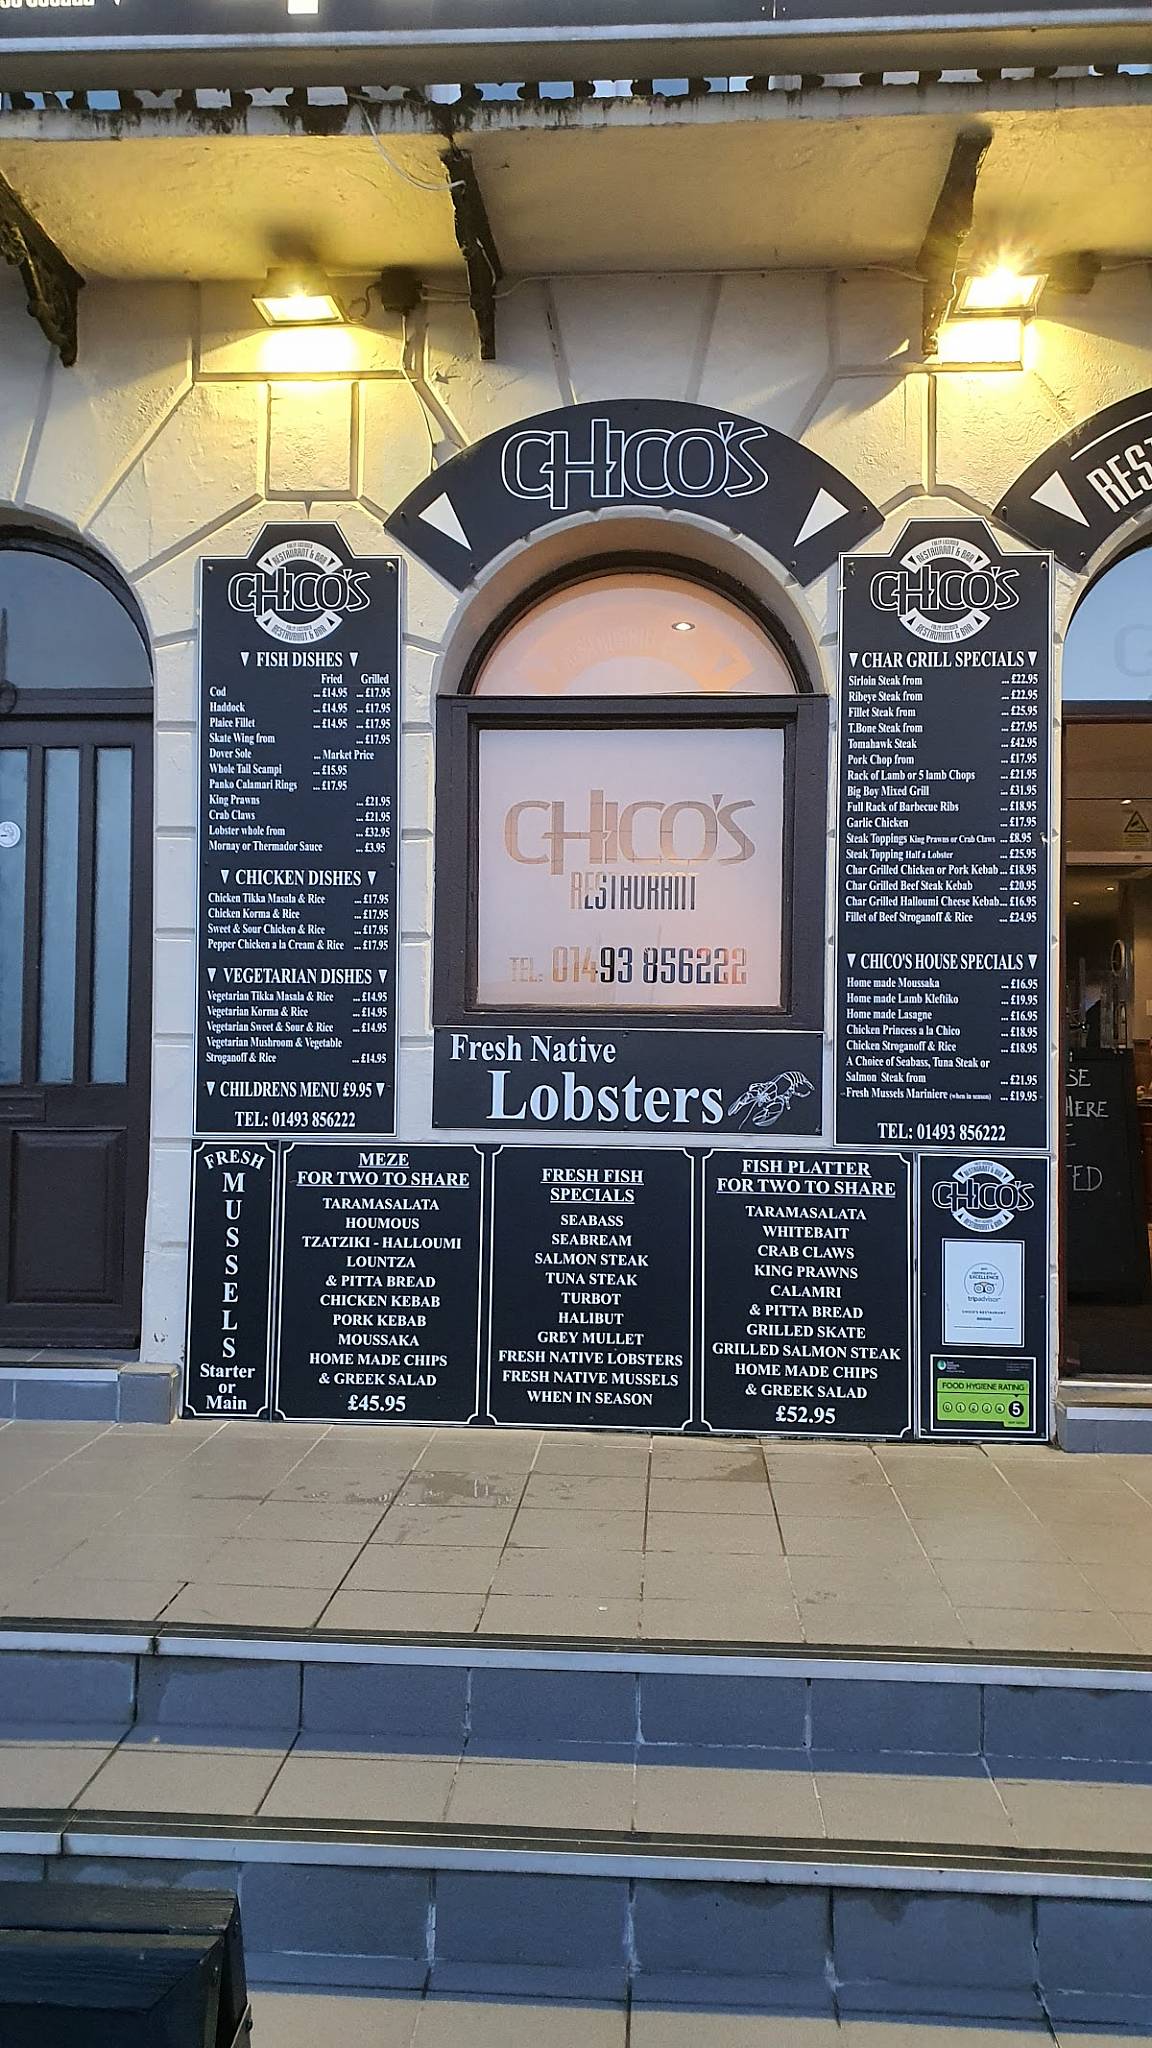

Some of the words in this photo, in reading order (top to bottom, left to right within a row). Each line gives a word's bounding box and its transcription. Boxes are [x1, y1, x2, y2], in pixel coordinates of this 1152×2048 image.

[501, 419, 769, 509] CHICO'S
[1086, 438, 1152, 513] RES
[228, 566, 371, 617] CHICO'S
[870, 565, 1019, 616] CHICO'S
[256, 652, 288, 667] FISH
[292, 652, 343, 667] DISHES
[862, 652, 904, 668] CHAR
[906, 652, 952, 668] GRILL
[955, 651, 1024, 668] SPECIALS
[321, 674, 342, 684] Fried
[360, 674, 389, 684] Grilled
[848, 675, 876, 686] Sirloin
[878, 675, 901, 686] Steak
[902, 675, 922, 686] from
[210, 686, 226, 697] Cod
[210, 702, 245, 712] Haddock
[210, 717, 234, 728] Plaice
[235, 717, 255, 728] Fillet
[848, 722, 877, 733] T.Bone
[878, 722, 901, 733] Steak
[902, 722, 923, 733] from
[209, 732, 232, 743] Skate
[233, 732, 254, 746] Wing
[256, 732, 275, 743] from
[848, 738, 893, 749] Tomahawk
[894, 738, 917, 749] Steak
[209, 763, 235, 774] Whole
[236, 763, 251, 774] Tail
[252, 763, 282, 777] Scampi
[847, 786, 862, 799] Big
[863, 786, 880, 799] Boy
[881, 785, 907, 796] Mixed
[909, 785, 929, 796] Grill
[208, 809, 230, 820] Crab
[231, 809, 256, 820] Claws
[846, 817, 873, 828] Garlic
[874, 817, 908, 828] Chicken
[504, 789, 756, 876] CHICO'S
[235, 869, 305, 886] CHICKEN
[308, 870, 362, 886] DISHES
[208, 908, 240, 918] Chicken
[242, 908, 271, 918] Korma
[272, 908, 280, 919] &
[282, 908, 300, 919] Rice
[551, 946, 634, 985] 01493
[642, 947, 747, 986] 856222
[860, 953, 912, 970] CHICO'S
[915, 953, 958, 970] HOUSE
[960, 954, 1023, 970] SPECIALS
[223, 968, 317, 984] VEGETARIAN
[320, 968, 372, 984] DISHES
[847, 977, 872, 988] Home
[873, 977, 896, 988] made
[898, 977, 940, 988] Moussaka
[449, 1033, 522, 1062] Fresh
[530, 1035, 617, 1064] Native
[206, 1052, 248, 1065] Stroganoff
[248, 1052, 256, 1062] &
[258, 1052, 277, 1062] Rice
[846, 1071, 877, 1082] Salmon
[881, 1072, 904, 1082] Steak
[906, 1072, 926, 1083] from
[220, 1081, 297, 1098] CHILDRENS
[300, 1082, 339, 1098] MENU
[342, 1082, 372, 1098] £9.95
[485, 1070, 724, 1125] Lobsters
[234, 1111, 268, 1127] TEL:
[272, 1111, 308, 1127] 01493
[312, 1112, 356, 1127] 856222
[877, 1122, 912, 1139] TEL:
[917, 1123, 956, 1140] 01493
[959, 1124, 1006, 1141] 856222
[204, 1149, 266, 1170] FRESH
[358, 1152, 409, 1167] MEZE
[742, 1159, 784, 1173] FISH
[788, 1160, 871, 1176] PLATTER
[297, 1171, 334, 1185] FOR
[337, 1172, 378, 1186] TWO
[382, 1172, 408, 1186] TO
[411, 1173, 470, 1187] SHARE
[540, 1168, 599, 1183] FRESH
[604, 1169, 643, 1183] FISH
[717, 1178, 755, 1192] FOR
[760, 1179, 801, 1194] TWO
[807, 1180, 829, 1194] TO
[832, 1181, 896, 1196] SHARE
[550, 1187, 634, 1202] SPECIALS
[932, 1178, 1034, 1212] CHICO'S
[322, 1198, 440, 1210] TARAMASALATA
[346, 1217, 420, 1230] HOUMOUS
[560, 1214, 624, 1227] SEABASS
[762, 1225, 850, 1239] WHITEBAIT
[302, 1236, 370, 1248] TZATZIKI
[382, 1237, 461, 1249] HALLOUMI
[552, 1234, 632, 1246] SEABREAM
[758, 1244, 799, 1257] CRAB
[802, 1246, 854, 1259] CLAWS
[347, 1256, 416, 1268] LOUNTZA
[534, 1252, 597, 1265] SALMON
[600, 1254, 648, 1266] STEAK
[754, 1264, 793, 1277] KING
[797, 1266, 858, 1279] PRAWNS
[325, 1274, 337, 1286] &
[341, 1275, 383, 1287] PITTA
[386, 1276, 436, 1288] BREAD
[770, 1284, 841, 1298] CALAMRI
[320, 1294, 387, 1306] CHICKEN
[391, 1295, 440, 1308] KEBAB
[561, 1292, 622, 1305] TURBOT
[333, 1314, 374, 1326] PORK
[377, 1314, 426, 1327] KEBAB
[558, 1312, 624, 1325] HALIBUT
[338, 1334, 420, 1346] MOUSSAKA
[537, 1331, 578, 1344] GREY
[582, 1332, 644, 1345] MULLET
[498, 1350, 546, 1362] FRESH
[549, 1351, 604, 1364] NATIVE
[607, 1353, 683, 1366] LOBSTERS
[712, 1342, 780, 1356] GRILLED
[782, 1344, 847, 1358] SALMON
[850, 1346, 901, 1360] STEAK
[310, 1352, 354, 1365] HOME
[358, 1354, 400, 1366] MADE
[404, 1354, 447, 1366] CHIPS
[200, 1363, 256, 1378] Starter
[218, 1383, 236, 1394] or
[206, 1395, 247, 1410] Main
[348, 1394, 406, 1412] £45.95
[527, 1390, 572, 1403] WHEN
[576, 1392, 592, 1404] IN
[595, 1392, 653, 1405] SEASON
[776, 1405, 836, 1424] £52.95
